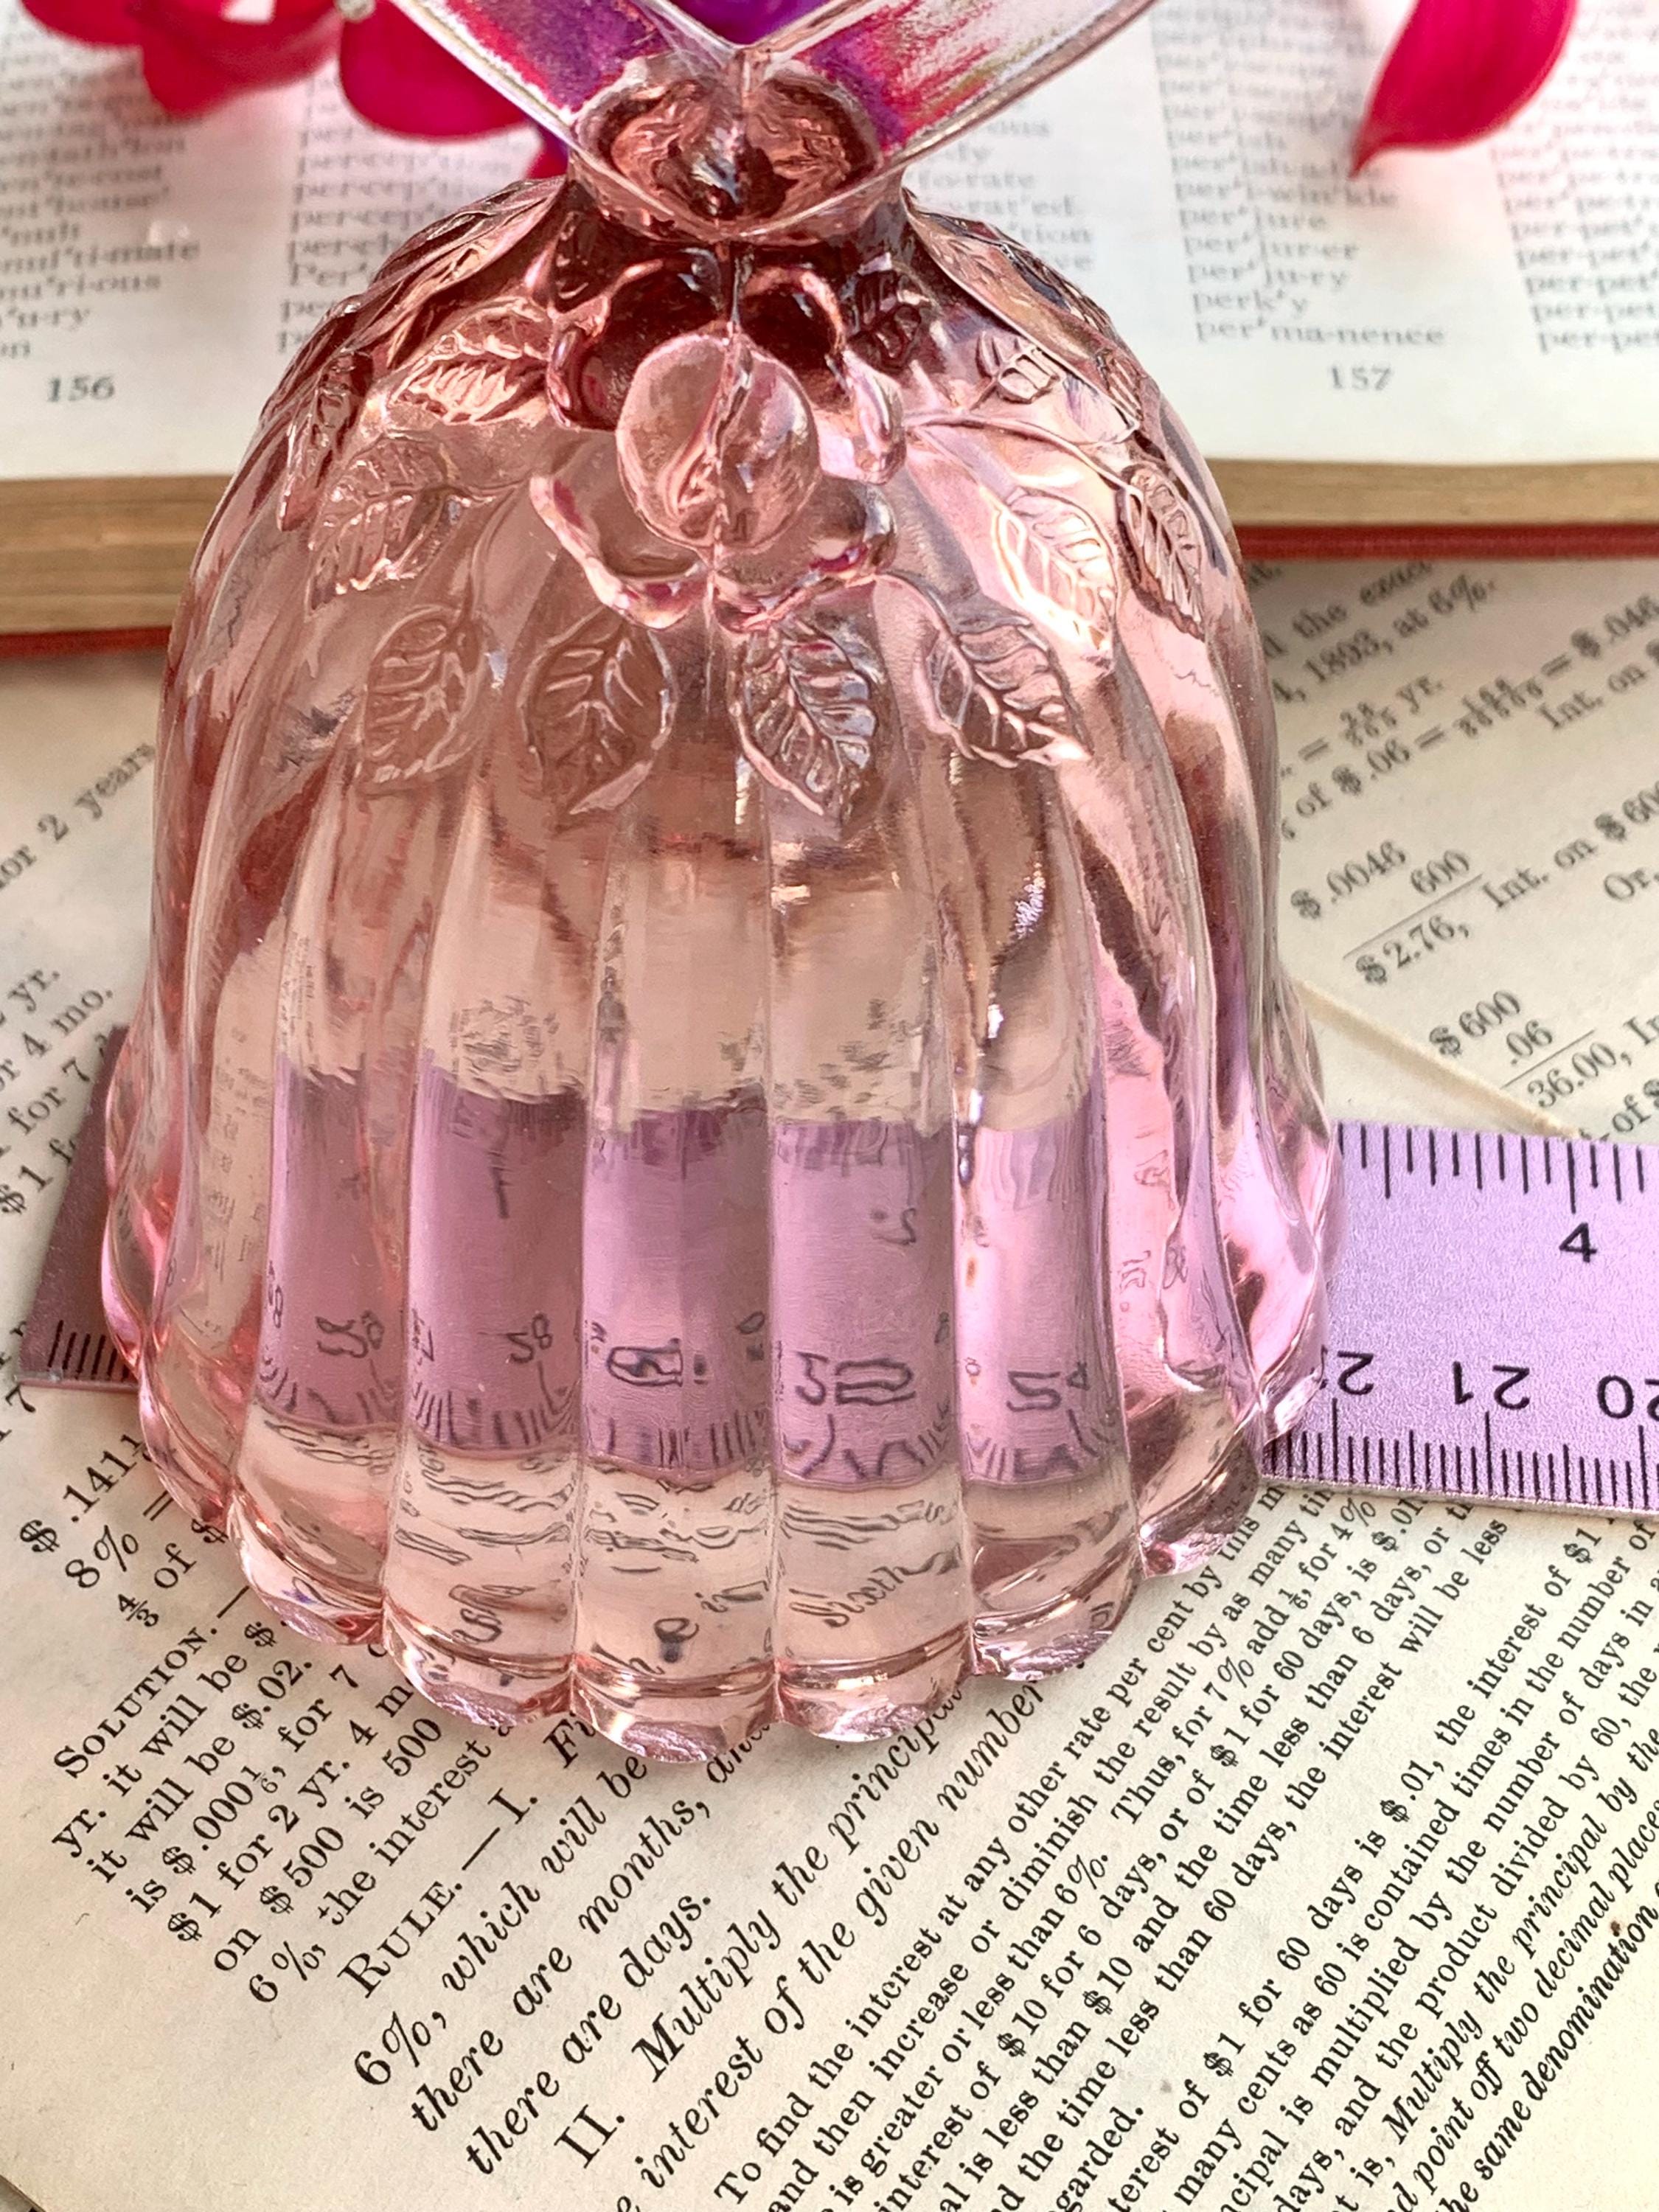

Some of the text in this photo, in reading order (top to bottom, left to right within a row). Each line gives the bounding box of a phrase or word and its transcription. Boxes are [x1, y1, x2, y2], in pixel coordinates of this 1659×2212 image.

[46, 375, 115, 402] 156
[1329, 364, 1392, 391] 157
[1392, 607, 1430, 639] at
[1607, 664, 1647, 693] on
[37, 814, 70, 842] 2
[1411, 838, 1599, 909] 600 Int. on
[7, 970, 60, 1014] yr.
[7, 1056, 91, 1135] for 7
[23, 989, 113, 1059] 4 mo.
[1558, 1221, 1598, 1264] 4
[1451, 1360, 1531, 1411] 21
[154, 1543, 196, 1588] of
[52, 1655, 247, 1858] yr. it will be
[86, 1737, 234, 1883] it will be
[125, 1664, 358, 1913] is for 7
[215, 1719, 442, 1971] on is 500
[218, 1720, 378, 1891] for 2 yr. 4
[318, 1740, 491, 1925] the interest
[442, 1882, 540, 1991] which
[541, 1796, 606, 1874] will
[597, 1753, 649, 1799] be
[768, 1520, 1307, 2212] and then increase or diminish the result as many
[1018, 1520, 1507, 2181] the time interest will be less
[1133, 1565, 1430, 1953] and time less than days,
[1174, 1557, 1630, 2205] many cents contained times in number
[1179, 1604, 1547, 2118] of 60 days is the interest
[1280, 1632, 1630, 2125] is multiplied by the number of days
[411, 1801, 709, 2131] there are months,
[554, 2104, 625, 2168] II.
[631, 1910, 780, 2082] Multiply
[772, 1846, 828, 1906] the
[635, 1680, 1045, 2188] interest of the given number
[714, 1565, 1222, 2204] To find the interest at any other rate per cent by
[830, 1604, 1290, 2205] is greater less than Thus, for add
[874, 1559, 1377, 2212] interest of for 6 days, or 60 is
[1273, 1668, 1657, 2212] days, product divided 60, the
[1350, 1778, 1637, 2188] is, Multiply the principal by
[466, 1896, 711, 2174] there are days.
[1413, 1882, 1615, 2195] point off two decimal
[1474, 1906, 1658, 2180] same denomination
